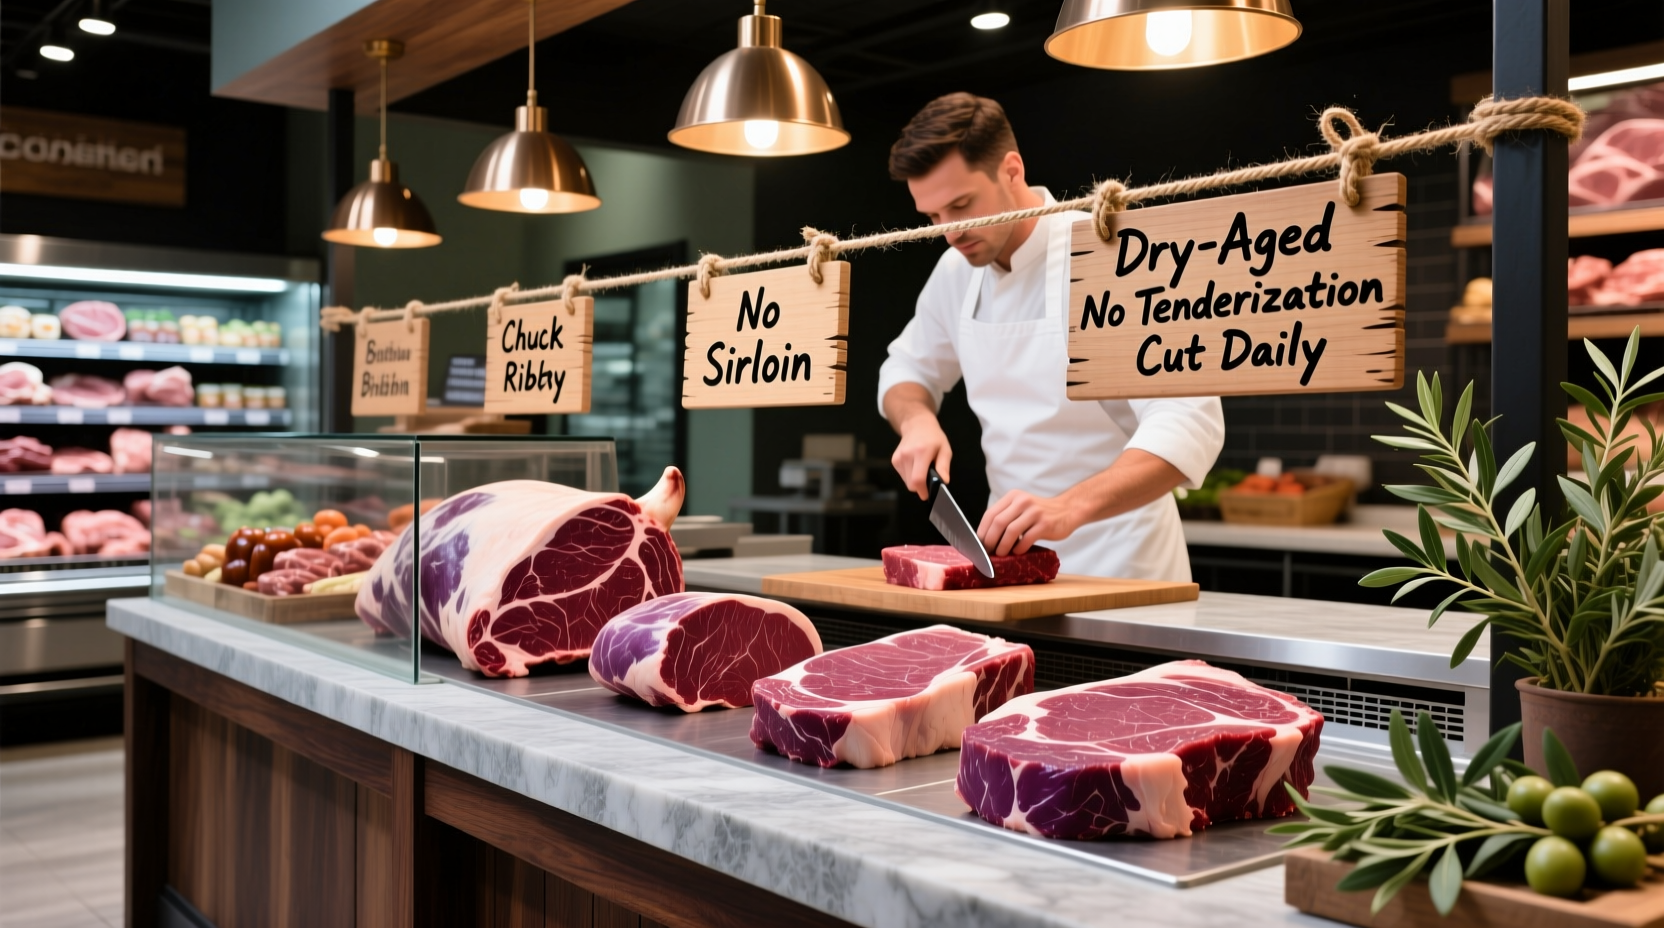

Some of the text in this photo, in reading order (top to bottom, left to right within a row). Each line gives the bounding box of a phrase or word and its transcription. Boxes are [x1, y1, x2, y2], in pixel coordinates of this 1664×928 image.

[1115, 201, 1336, 289] Dry-Aged
[736, 286, 781, 332] No
[1080, 271, 1384, 331] No Tenderization
[501, 315, 564, 354] Chuck
[1136, 320, 1328, 387] Cut Daily
[702, 338, 812, 387] Sirloin
